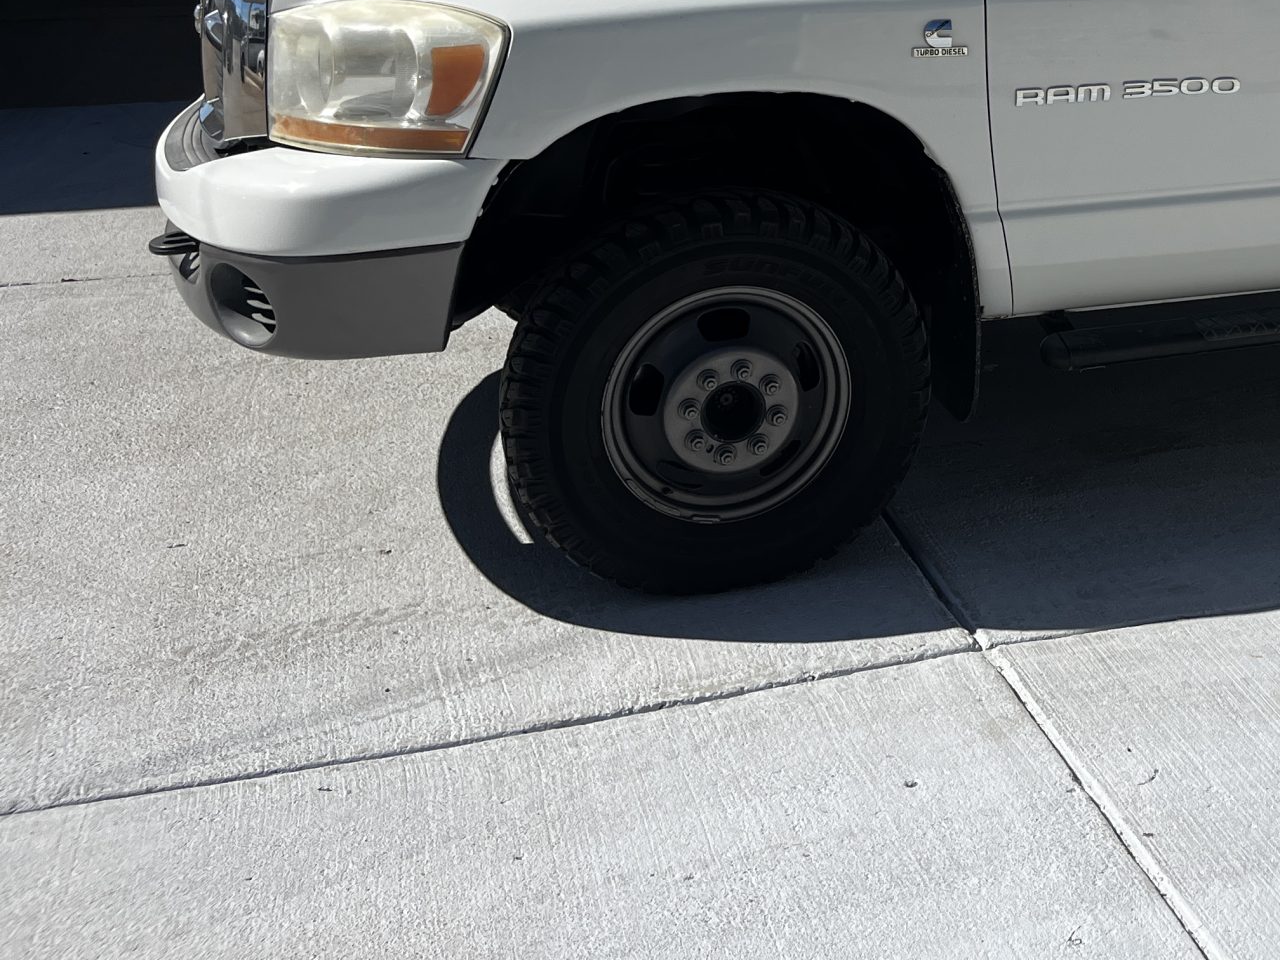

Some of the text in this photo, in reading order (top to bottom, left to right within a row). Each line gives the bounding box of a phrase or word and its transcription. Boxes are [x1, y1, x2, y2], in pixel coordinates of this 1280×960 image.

[915, 47, 965, 57] TURBO DIESEL
[1015, 76, 1241, 107] RAM 3500
